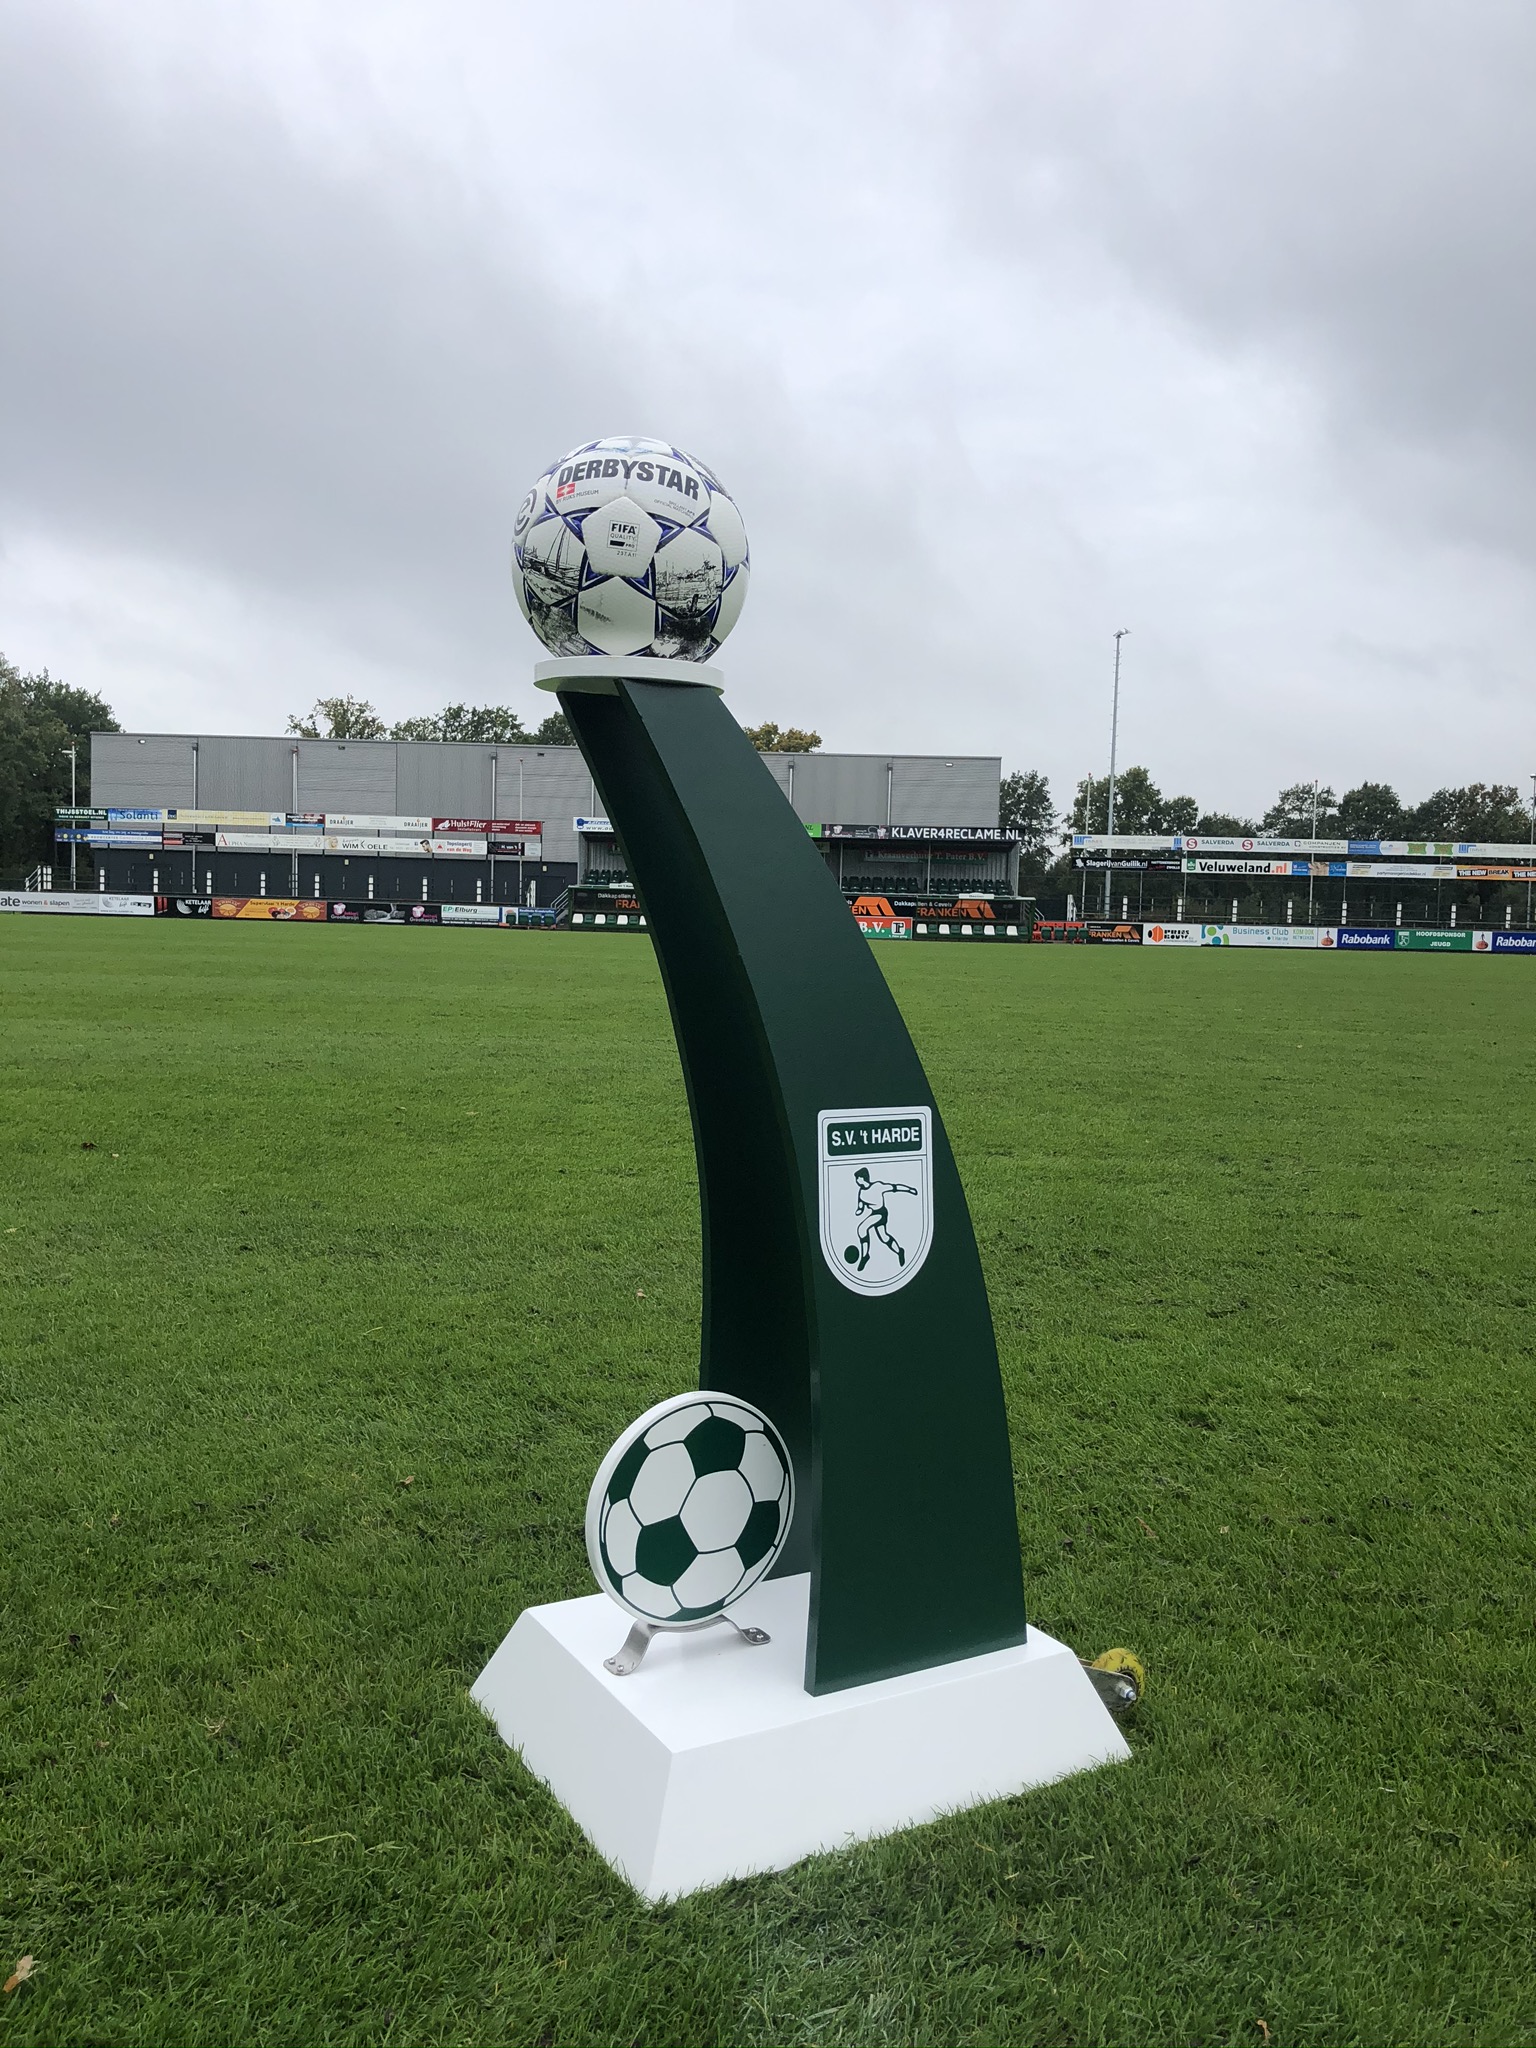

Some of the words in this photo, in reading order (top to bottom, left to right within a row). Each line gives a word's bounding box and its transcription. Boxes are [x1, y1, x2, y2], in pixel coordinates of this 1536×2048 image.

[557, 458, 700, 501] DERBYSTAR
[576, 489, 600, 497] MUSEUM
[611, 523, 637, 535] FIFA
[610, 532, 636, 541] QUALITY
[56, 808, 107, 816] THIJSSTOEL.NL
[120, 811, 158, 820] Solanti
[450, 819, 487, 829] HulstFlier
[891, 827, 1023, 841] KLAVER4RECLAME.NL
[1199, 861, 1288, 874] Veluweland.nl
[1458, 869, 1472, 877] THE
[1513, 870, 1527, 878] THE
[1, 896, 20, 906] ate
[49, 899, 70, 907] slapen
[858, 921, 885, 933] B.V.
[1232, 927, 1270, 935] Business
[1089, 930, 1122, 938] FRANKEN
[1342, 933, 1390, 945] Rabobank
[831, 1130, 857, 1147] S.V.
[860, 1128, 869, 1144] 't
[871, 1127, 920, 1144] HARDE
